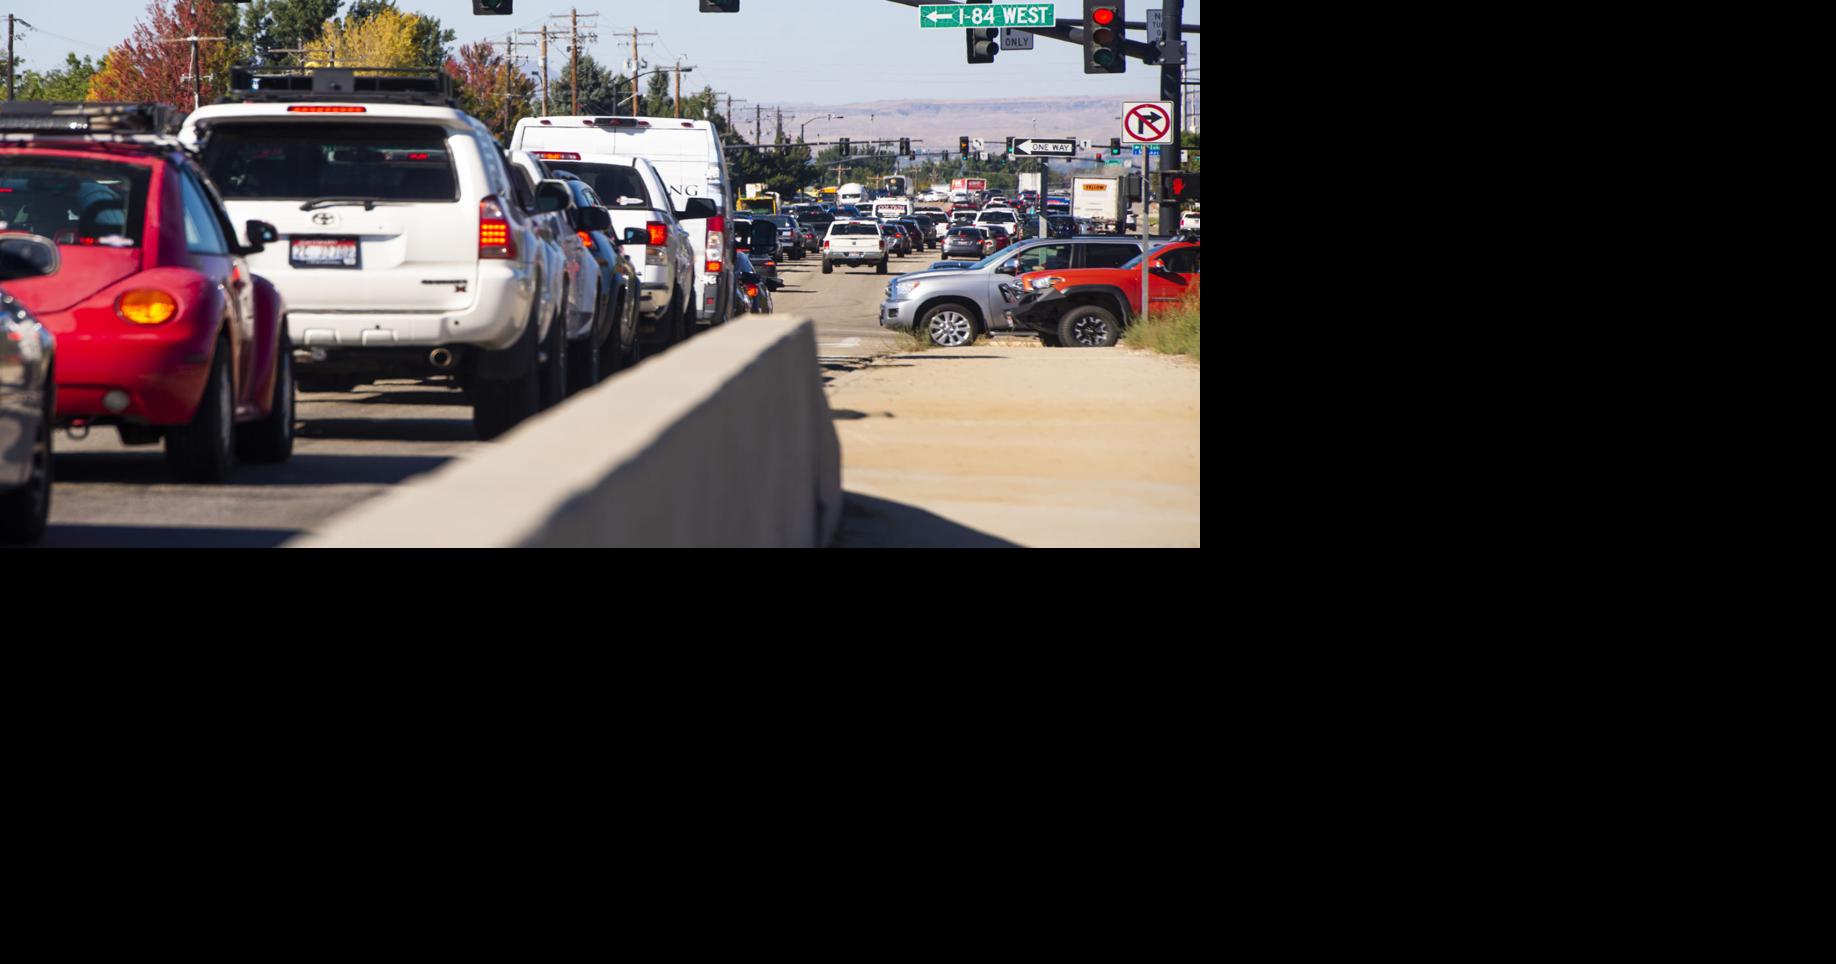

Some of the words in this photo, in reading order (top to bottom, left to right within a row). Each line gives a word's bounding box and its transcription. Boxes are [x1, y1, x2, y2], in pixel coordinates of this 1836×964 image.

[960, 8, 995, 25] I-84
[1002, 7, 1049, 24] WEST
[1005, 37, 1029, 47] ONLY
[1032, 143, 1049, 151] ONE
[1052, 144, 1070, 152] WAY
[670, 184, 699, 197] NG
